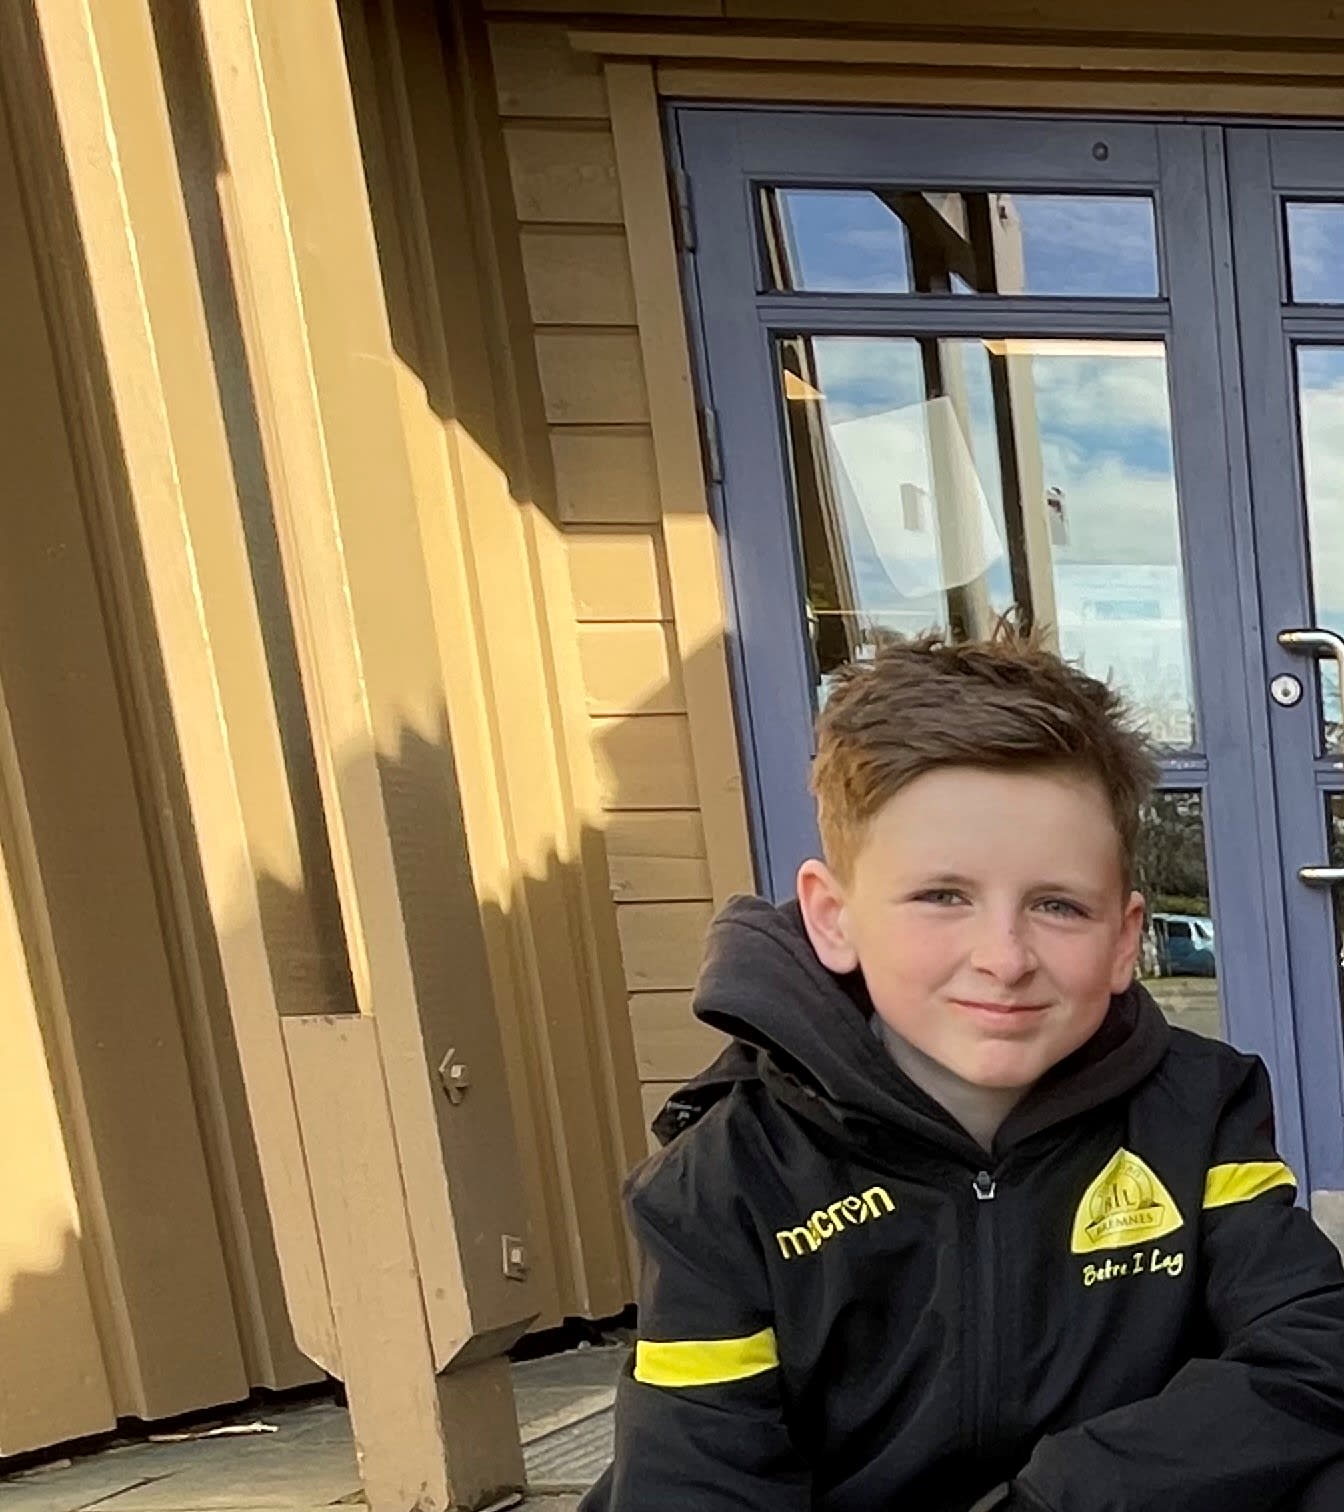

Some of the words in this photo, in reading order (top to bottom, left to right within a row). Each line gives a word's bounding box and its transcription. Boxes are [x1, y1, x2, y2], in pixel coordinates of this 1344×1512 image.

[1096, 1212, 1154, 1235] BREMNES
[1082, 1258, 1128, 1287] Betre
[1132, 1252, 1145, 1274] I
[1150, 1248, 1184, 1277] Lag
